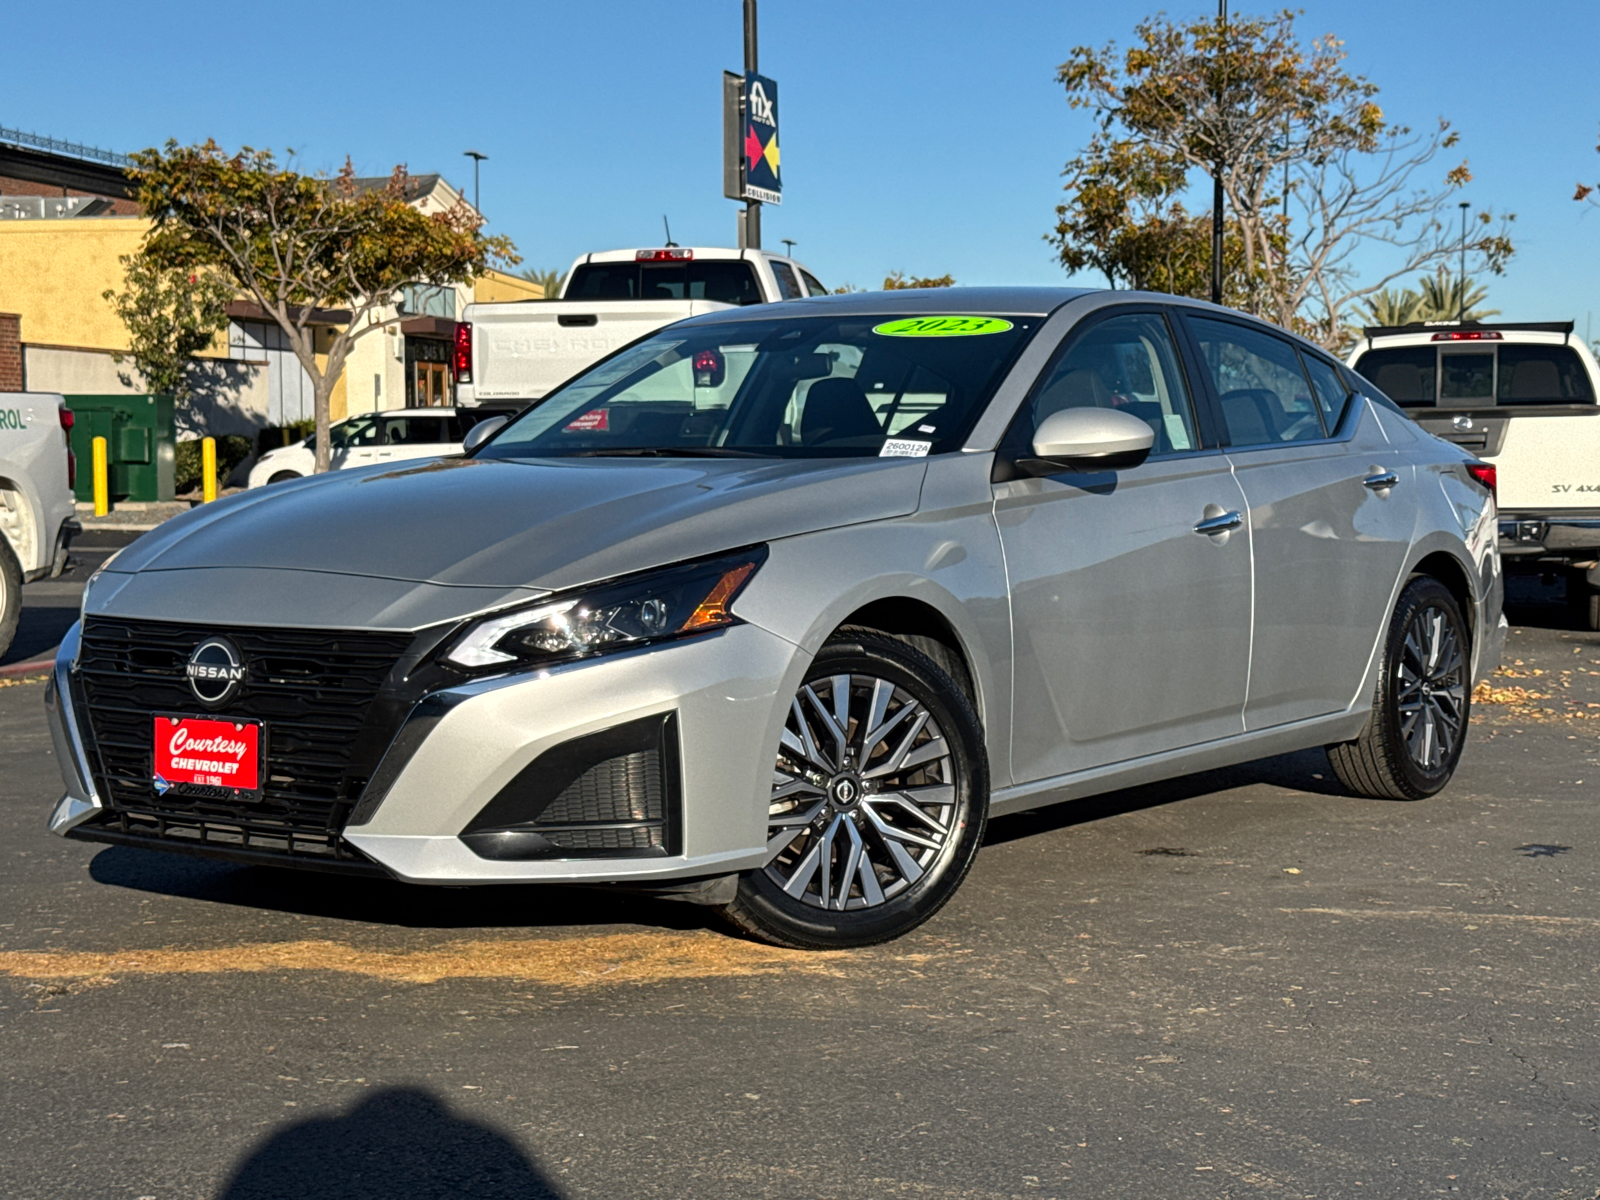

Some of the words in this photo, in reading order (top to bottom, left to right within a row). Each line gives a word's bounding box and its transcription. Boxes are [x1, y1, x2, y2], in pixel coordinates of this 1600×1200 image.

[747, 187, 781, 203] COLLISION
[892, 319, 993, 333] 2023
[494, 337, 611, 352] CHEVRO
[0, 408, 27, 430] ROL
[886, 442, 928, 452] 260012A
[1551, 484, 1572, 493] SV
[186, 665, 242, 680] NISSAN
[169, 728, 247, 761] Courtesy
[171, 757, 240, 774] CHEVROLET
[206, 775, 222, 787] 1961
